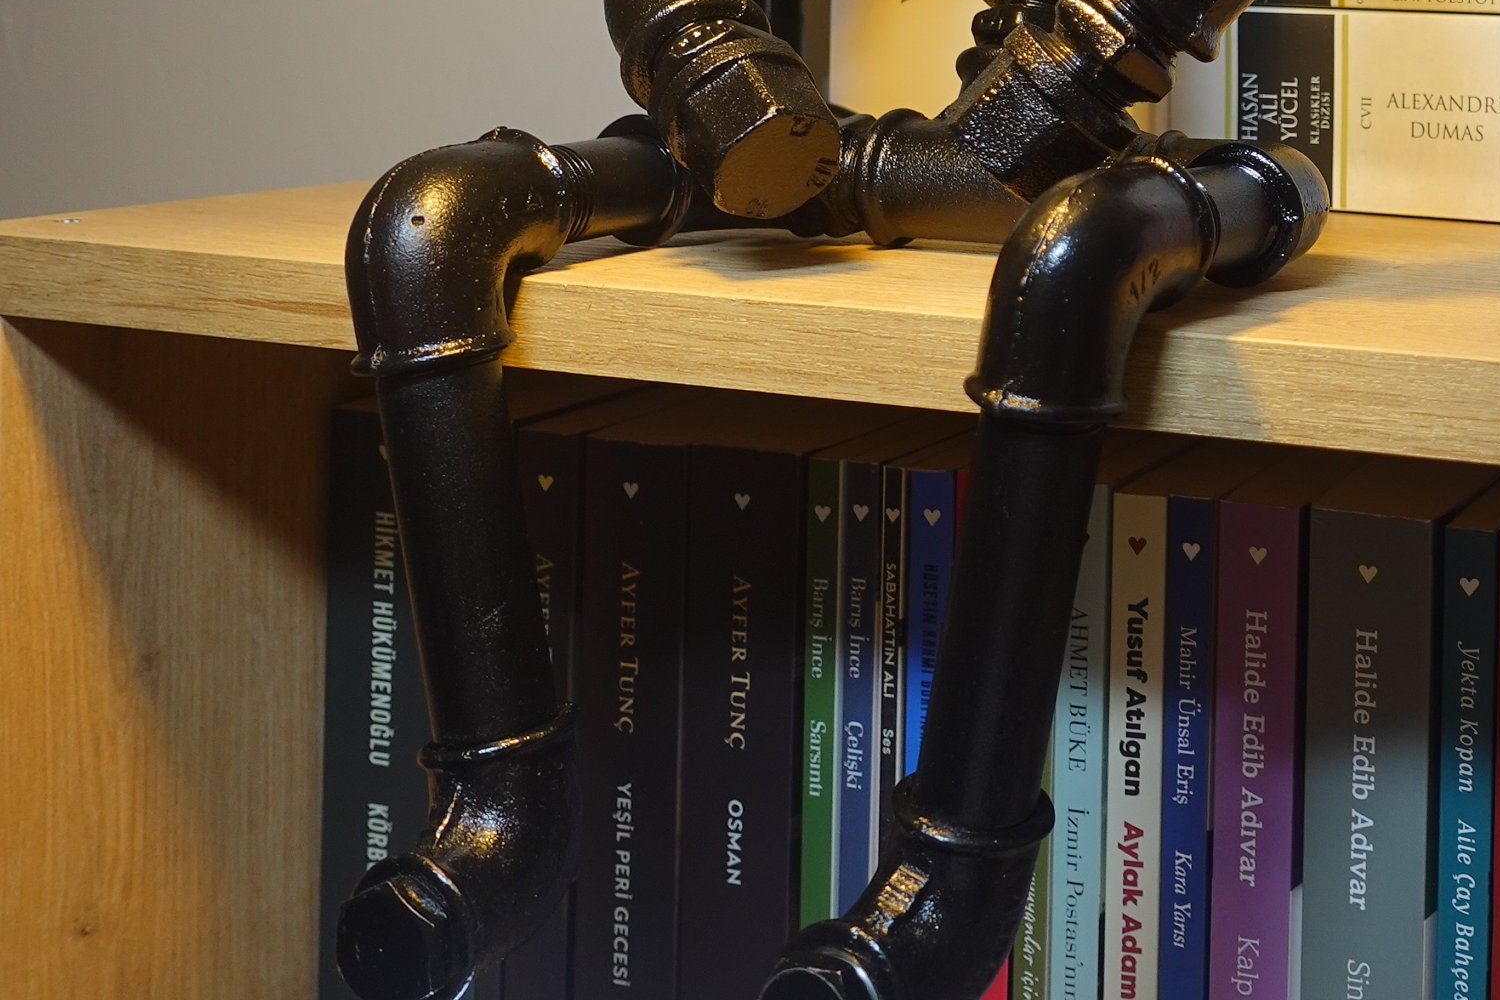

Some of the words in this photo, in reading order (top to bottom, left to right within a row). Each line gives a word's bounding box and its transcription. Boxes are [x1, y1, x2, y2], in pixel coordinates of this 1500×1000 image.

[1240, 73, 1258, 141] HASAN
[1280, 77, 1298, 143] YÜCEL
[1360, 96, 1372, 130] CVII
[1410, 121, 1485, 142] DUMAS
[373, 511, 400, 595] HİKMET
[811, 634, 833, 680] İnce
[849, 634, 871, 680] İnce
[1070, 607, 1089, 697] AHMET
[1126, 597, 1150, 684] Yusuf
[1178, 625, 1198, 690] Mahir
[1242, 608, 1268, 705] Halide
[368, 600, 398, 768] HÜKÜMENOĞLU
[1352, 628, 1379, 726] Halide
[1457, 640, 1481, 711] Yekta
[808, 719, 827, 797] Sarsıntı
[845, 719, 865, 790] Çelişki
[882, 728, 895, 755] Ses
[1068, 703, 1090, 772] BÜKE
[1118, 686, 1149, 797] Atılgan
[1176, 697, 1203, 757] Ünsal
[1241, 713, 1266, 779] Edib
[1454, 717, 1480, 793] Kopan
[1173, 763, 1196, 806] Eriş
[1350, 734, 1377, 801] Edib
[613, 782, 634, 840] YEŞİL
[726, 799, 744, 886] OSMAN
[1066, 805, 1091, 872] İzmir
[1239, 786, 1265, 888] Adıvar
[1456, 818, 1478, 867] Aile
[613, 849, 633, 900] PERİ
[1116, 820, 1146, 906] Aylak
[1173, 850, 1193, 896] Kara
[1348, 808, 1375, 911] Adıvar
[1171, 898, 1194, 950] Yarısı
[1450, 870, 1477, 917] Çay
[612, 905, 632, 988] GECESİ
[1119, 912, 1144, 1000] Adam
[1230, 935, 1260, 997] Kalp
